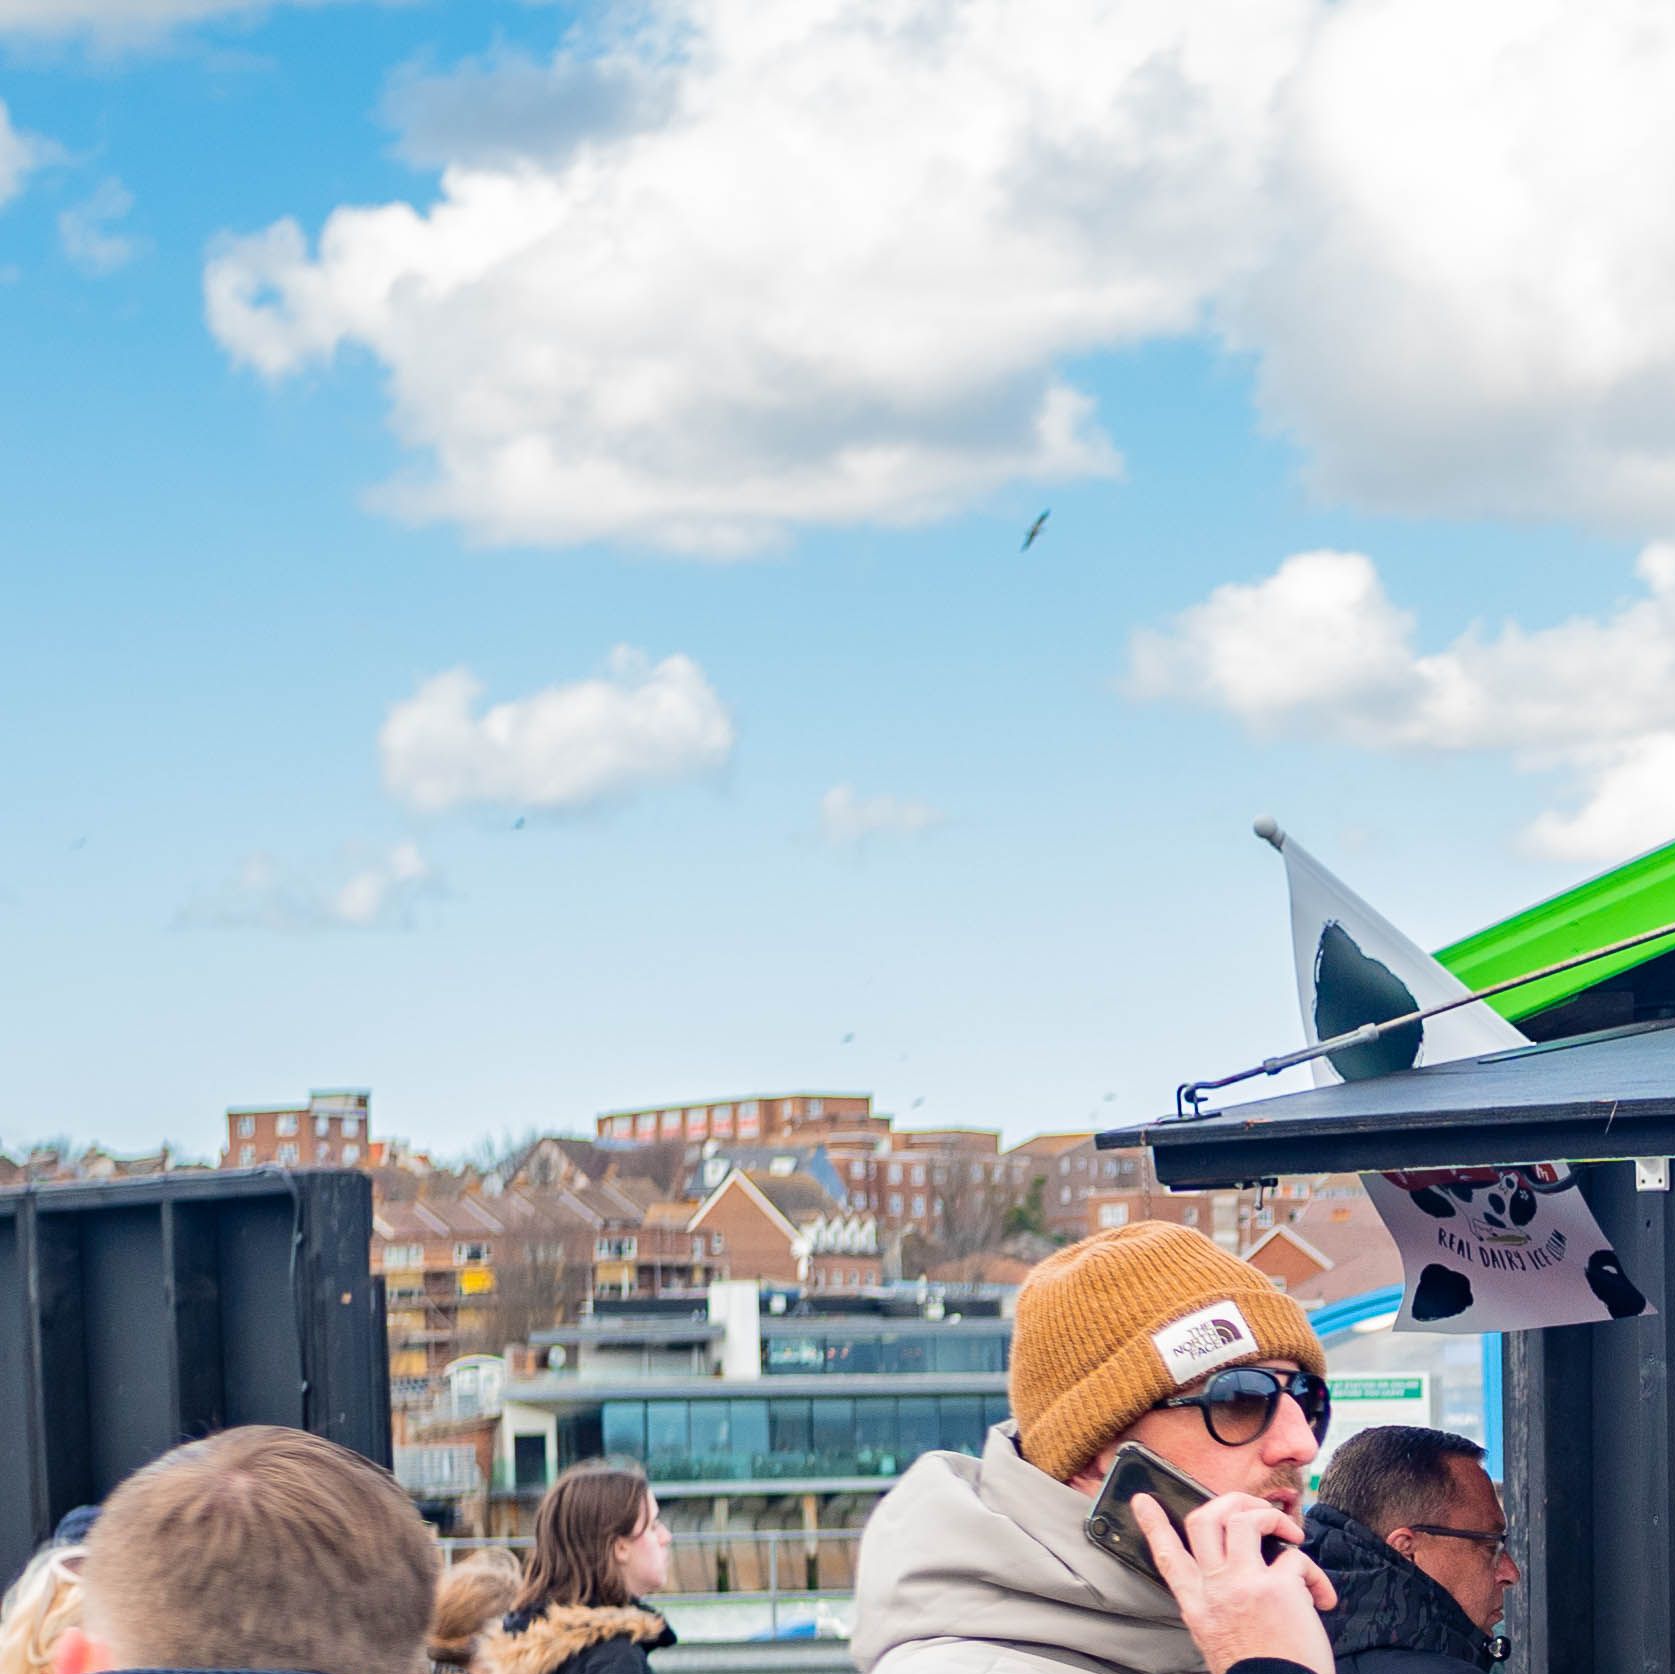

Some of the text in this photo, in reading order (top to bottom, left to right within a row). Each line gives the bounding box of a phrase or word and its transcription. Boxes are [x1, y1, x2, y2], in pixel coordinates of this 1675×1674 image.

[1438, 1227, 1473, 1262] REAL
[1478, 1246, 1526, 1271] DAIRY
[1526, 1247, 1552, 1270] ICE
[1190, 1339, 1222, 1361] FACE
